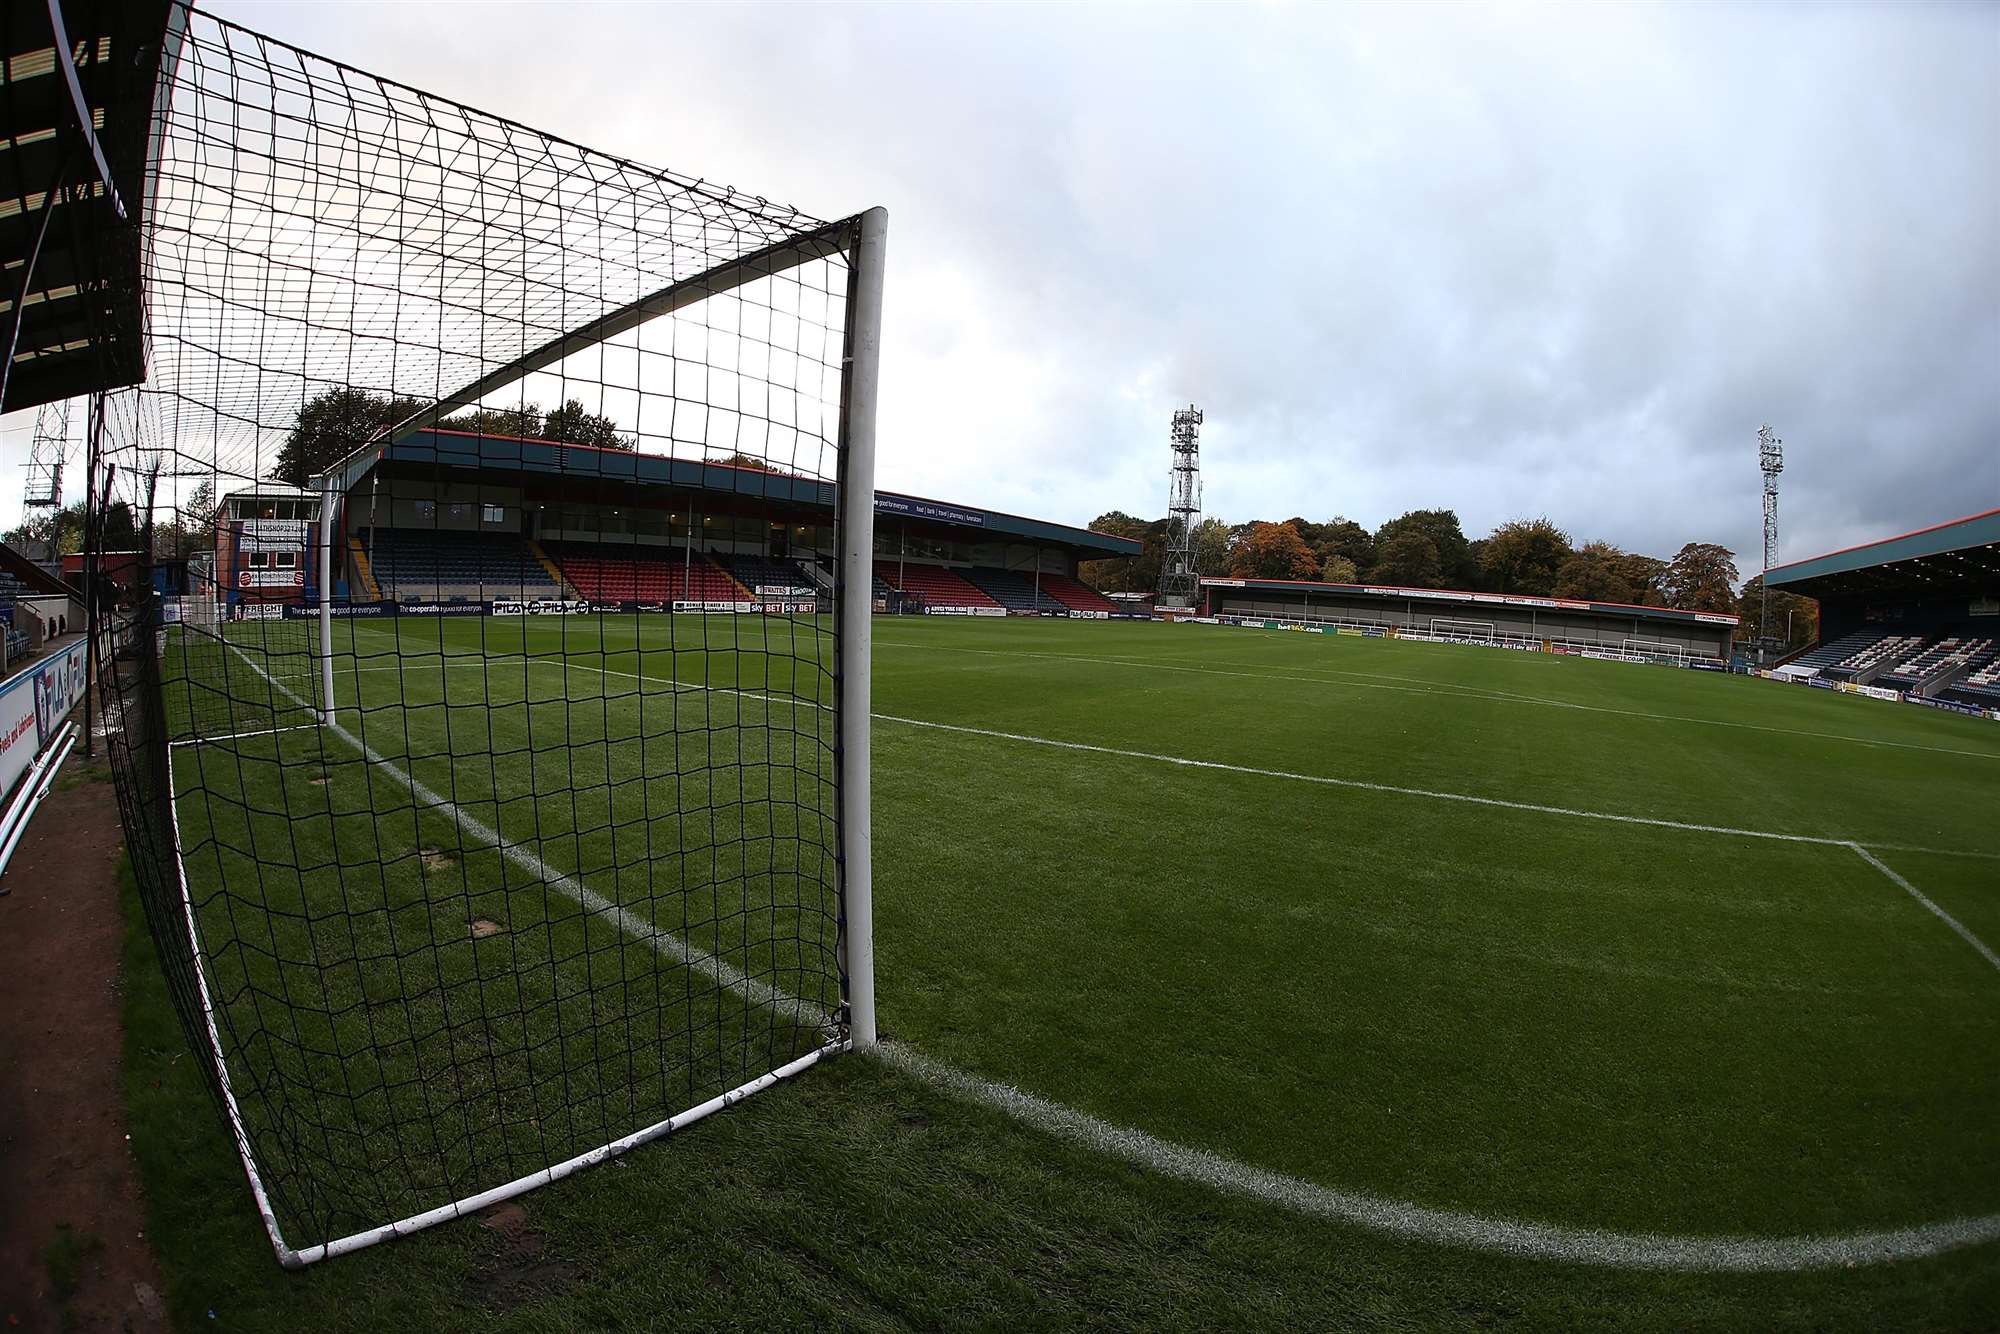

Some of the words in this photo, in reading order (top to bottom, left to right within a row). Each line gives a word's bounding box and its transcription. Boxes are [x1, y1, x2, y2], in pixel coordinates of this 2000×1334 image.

[246, 605, 282, 613] FREGHT
[336, 606, 350, 615] good
[358, 606, 381, 615] everyone
[463, 605, 482, 614] everyon
[766, 604, 781, 612] BET
[785, 603, 796, 613] sy
[799, 604, 813, 612] BET
[1277, 623, 1323, 634] bet365.com
